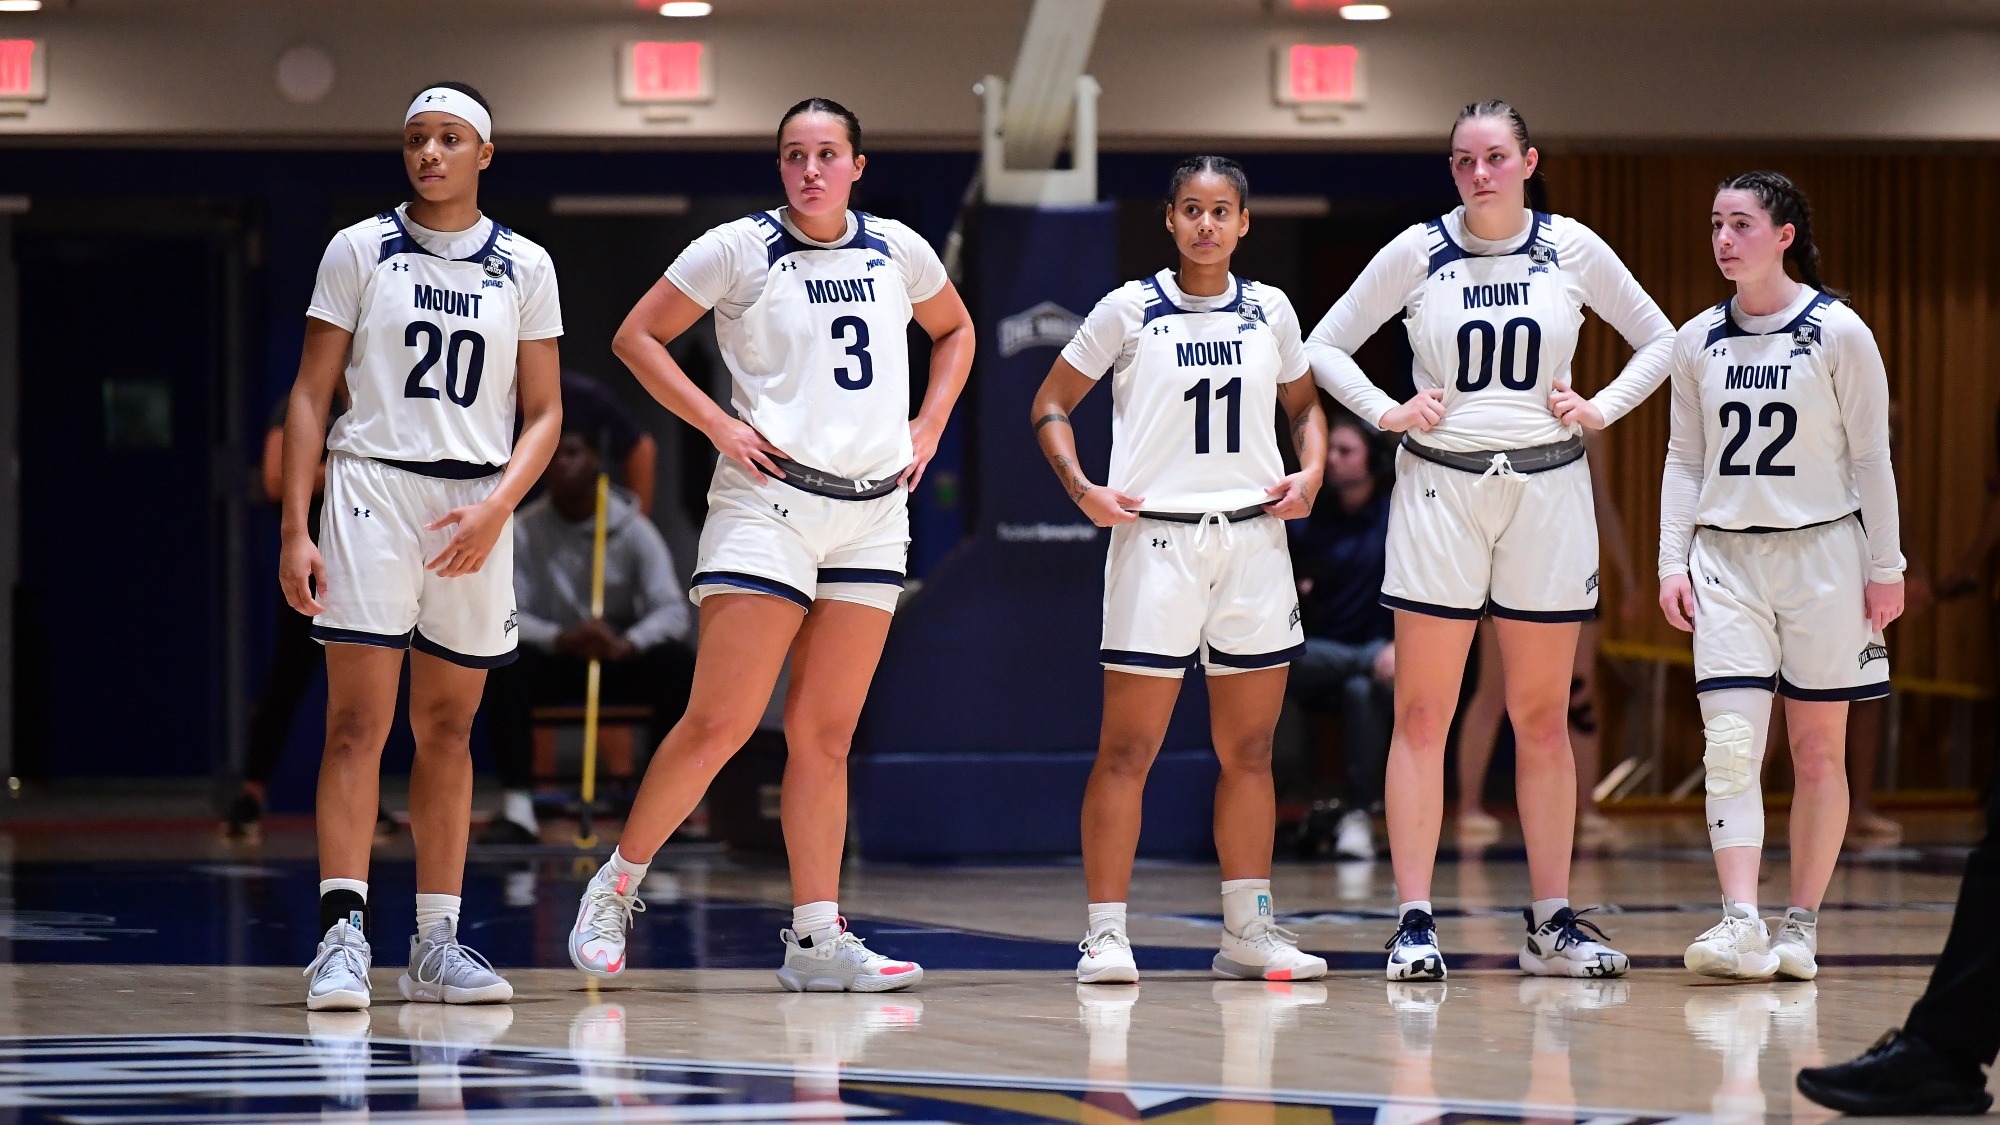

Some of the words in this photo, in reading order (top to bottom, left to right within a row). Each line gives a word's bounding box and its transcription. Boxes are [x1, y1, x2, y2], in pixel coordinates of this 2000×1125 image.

[414, 283, 483, 320] MOUNT
[804, 278, 876, 304] MOUNT
[1462, 282, 1531, 310] MOUNT
[404, 320, 486, 408] 20
[830, 315, 873, 391] 3
[1175, 340, 1243, 367] MOUNT
[1455, 316, 1542, 393] 00
[1724, 365, 1792, 390] MOUNT
[1183, 376, 1242, 455] 11
[1718, 401, 1798, 477] 22
[1868, 647, 1888, 659] MOU
